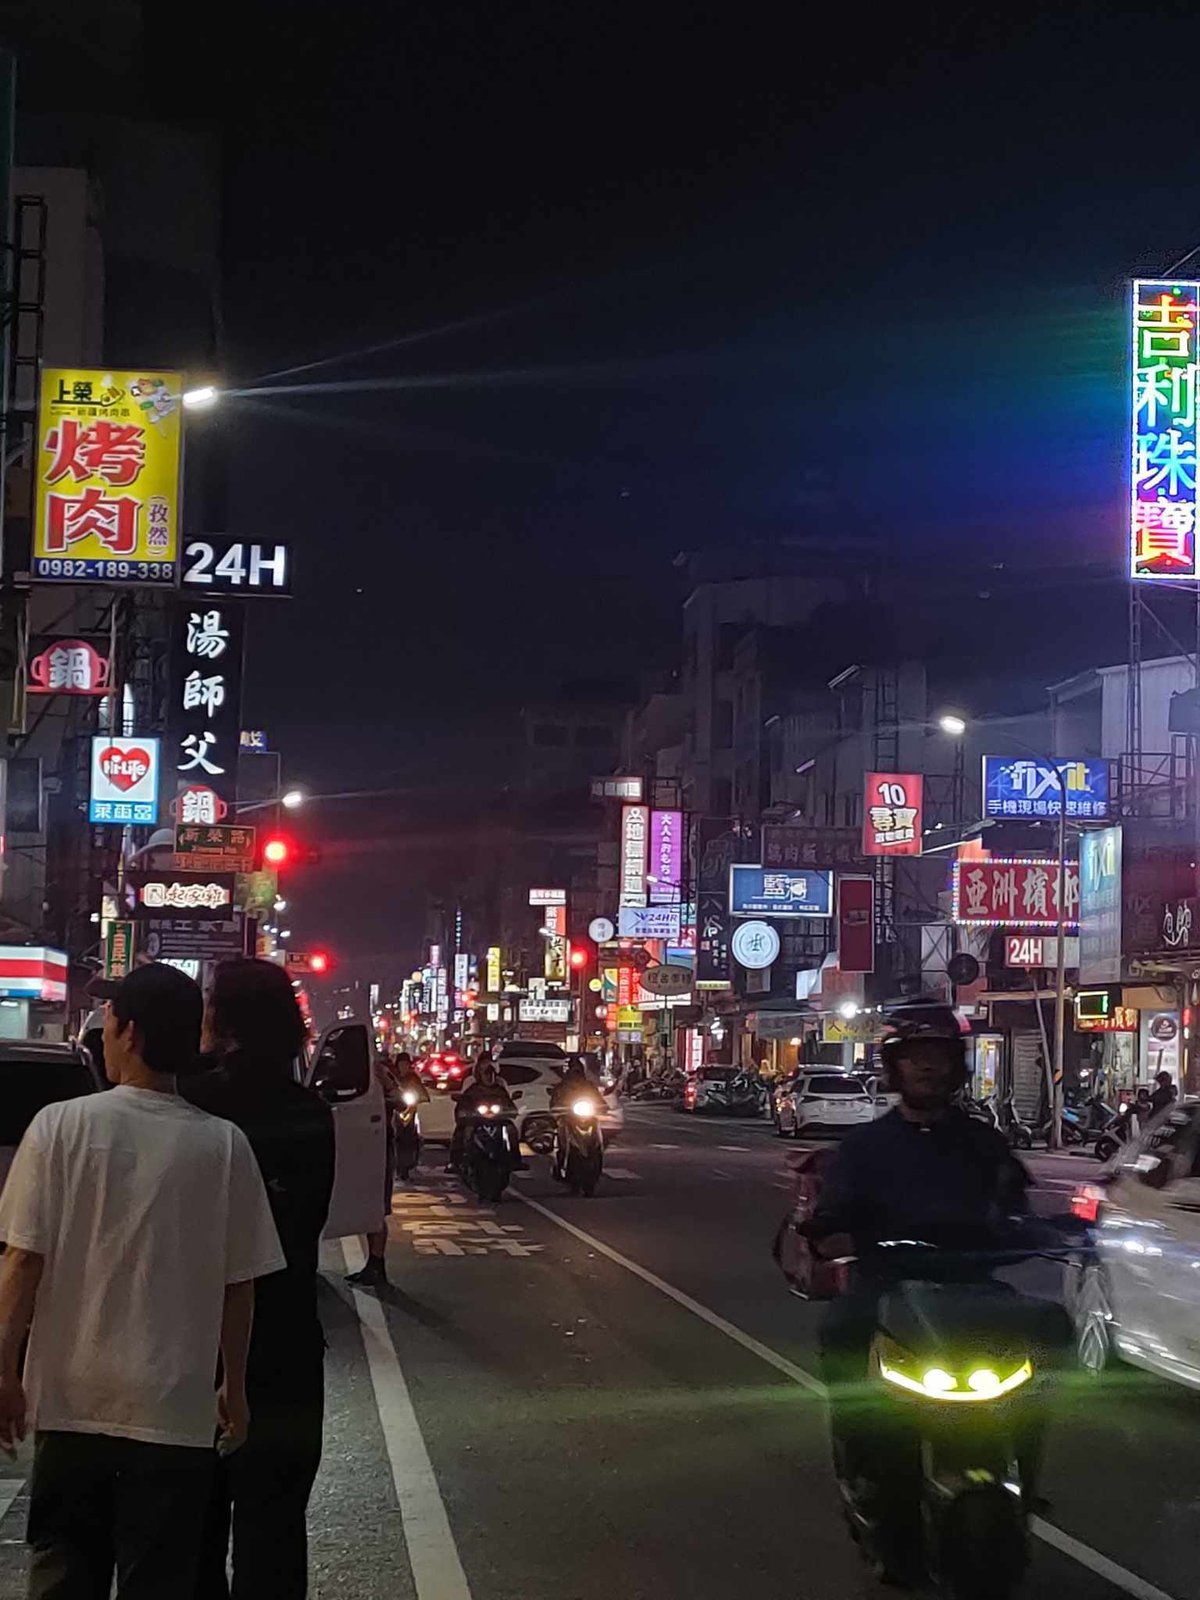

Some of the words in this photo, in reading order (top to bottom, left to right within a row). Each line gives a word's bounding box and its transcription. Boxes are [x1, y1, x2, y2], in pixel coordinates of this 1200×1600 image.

[1137, 293, 1196, 566] 吉利珠寶
[45, 418, 146, 555] 烤肉
[38, 559, 173, 580] 0982-189-338
[183, 542, 286, 586] 24H
[48, 647, 92, 690] 鍋
[177, 610, 230, 776] 湯師父
[103, 755, 147, 782] Hi-Life
[182, 790, 215, 824] 鍋
[878, 783, 906, 806] 10
[1010, 938, 1042, 964] 24H
